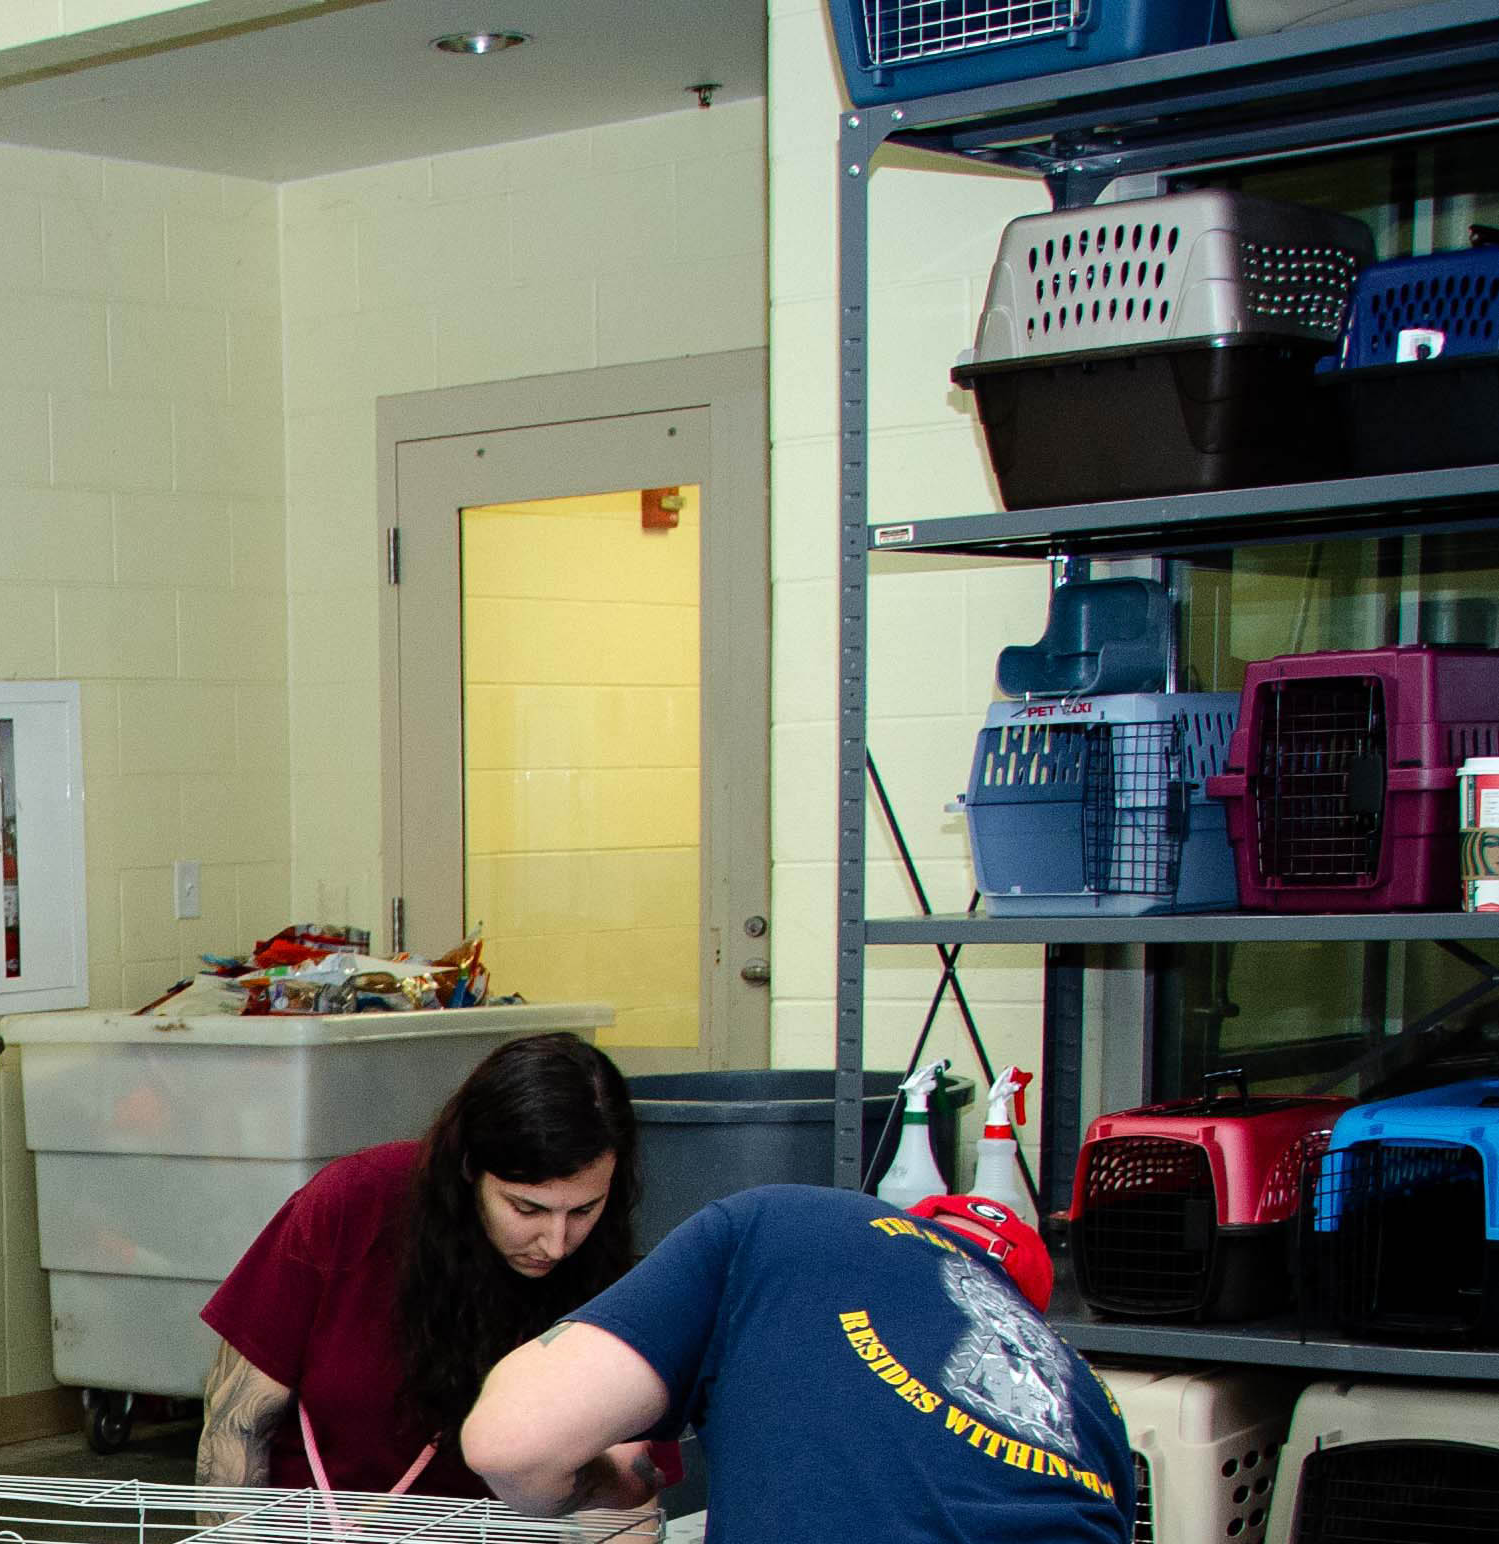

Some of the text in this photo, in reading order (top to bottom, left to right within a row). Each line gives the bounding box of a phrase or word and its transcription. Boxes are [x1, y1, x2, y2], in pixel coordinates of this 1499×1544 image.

[1026, 704, 1056, 717] PET
[839, 1310, 943, 1414] RESIDES
[944, 1405, 1070, 1479] WITHIN
